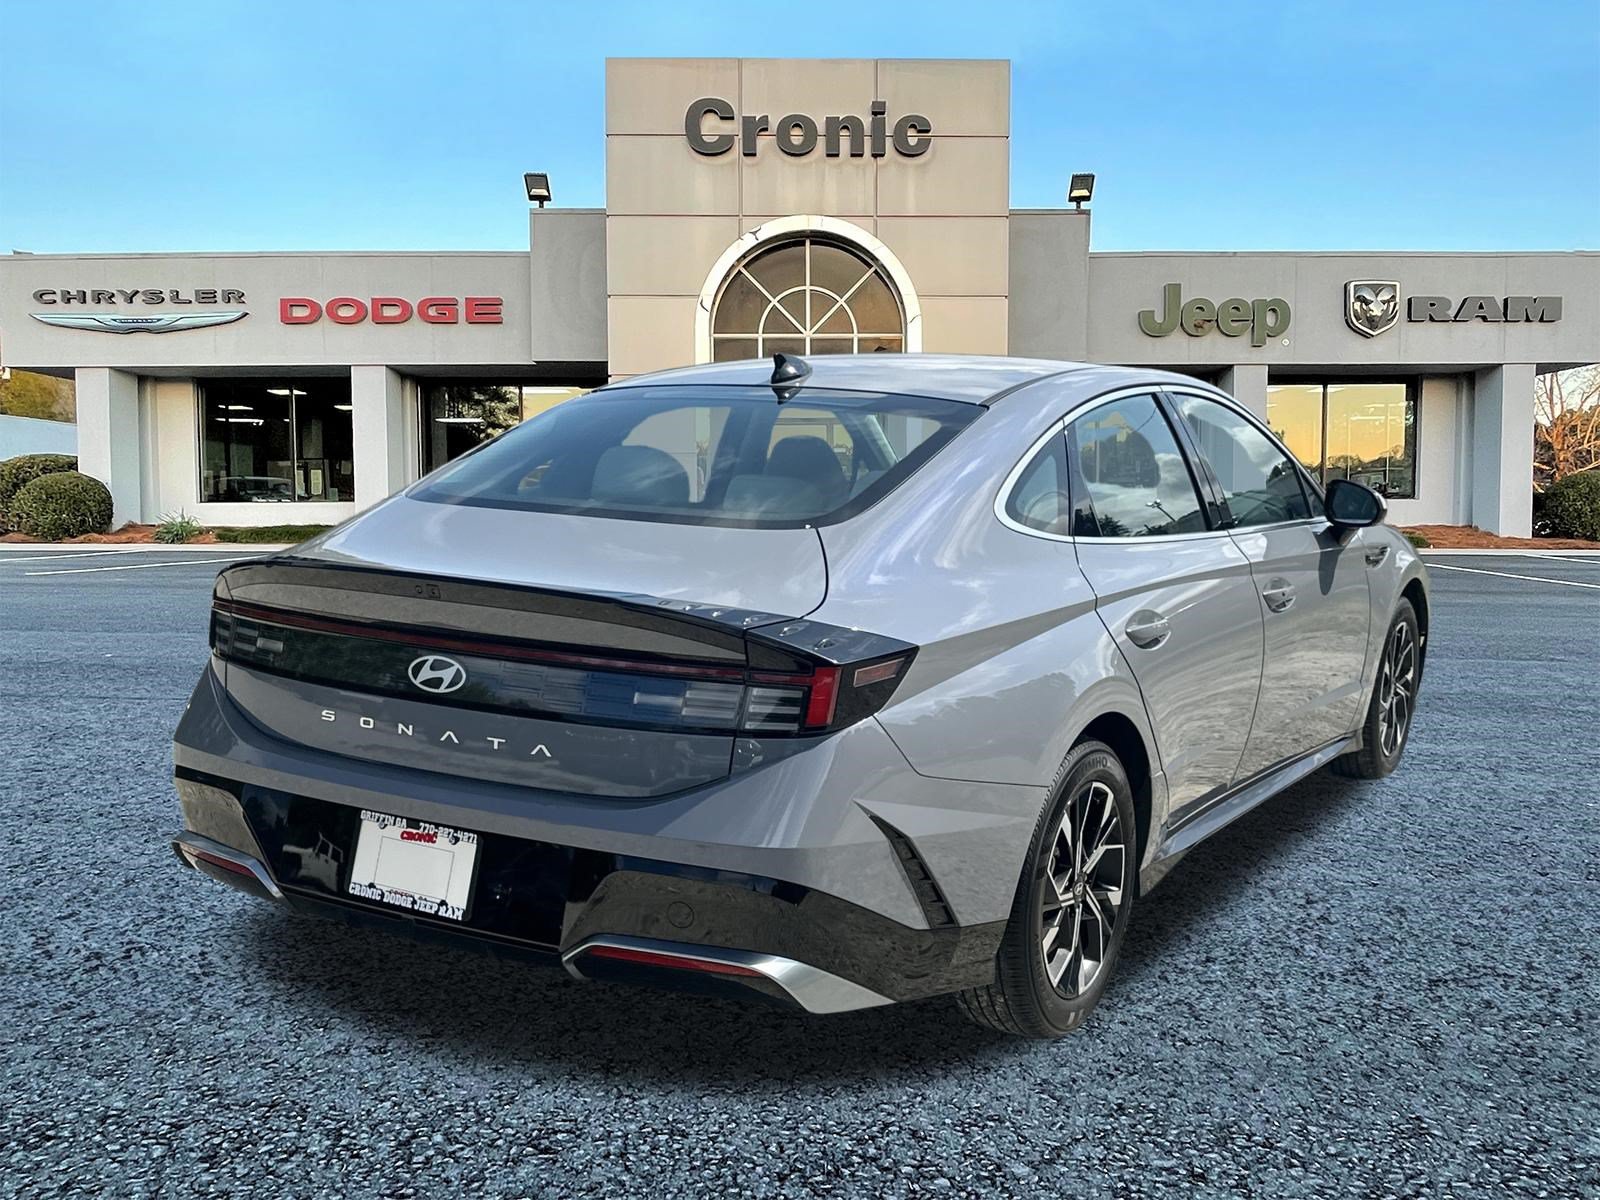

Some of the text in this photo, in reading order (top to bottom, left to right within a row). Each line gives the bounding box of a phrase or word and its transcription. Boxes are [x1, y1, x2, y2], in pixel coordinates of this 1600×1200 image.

[685, 97, 932, 158] Cronic
[32, 289, 246, 304] CHRYSLER
[279, 297, 503, 324] DODGE
[1138, 283, 1291, 347] Jeep
[1407, 296, 1563, 323] RAM
[320, 709, 552, 758] SONATA
[348, 883, 382, 901] CRONIC
[382, 891, 413, 908] DODGE
[413, 901, 438, 915] JEEP
[438, 906, 464, 921] RAM
